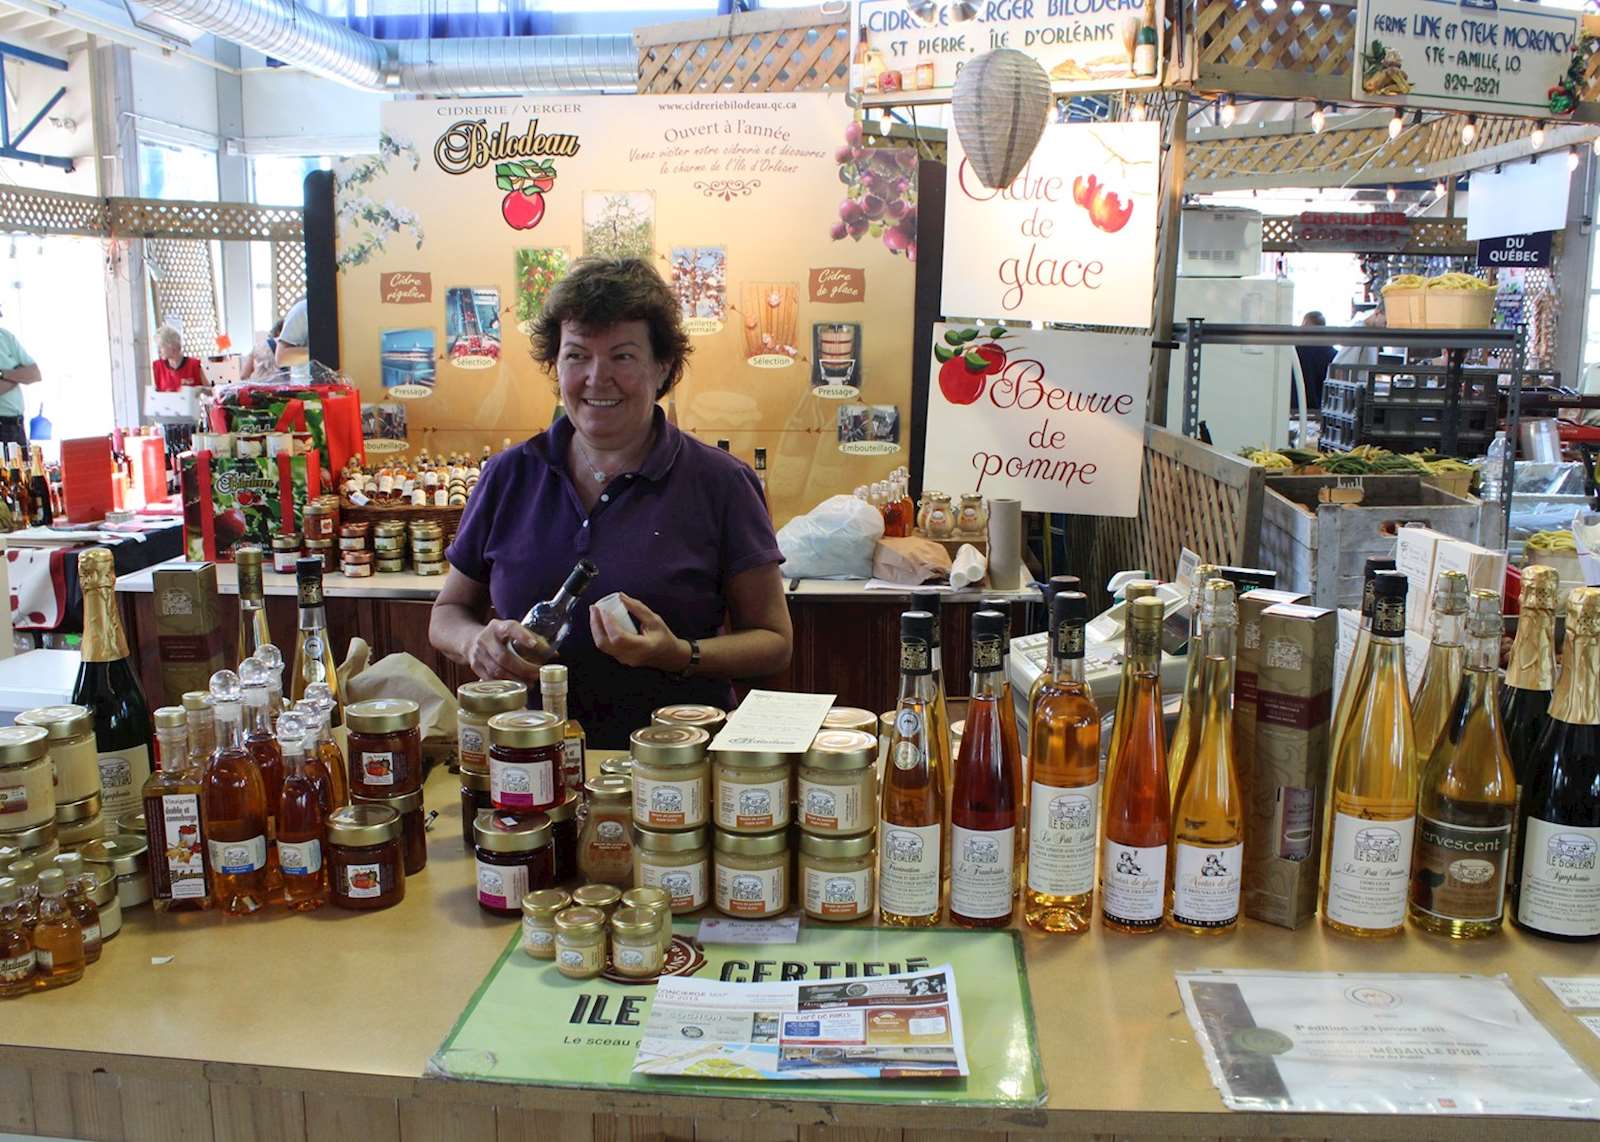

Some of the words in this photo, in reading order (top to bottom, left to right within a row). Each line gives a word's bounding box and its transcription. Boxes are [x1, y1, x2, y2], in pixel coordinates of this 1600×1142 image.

[868, 8, 949, 33] CIDRE
[978, 0, 1034, 22] RGER
[890, 42, 908, 56] ST
[1025, 21, 1115, 46] D'ORLÉANS
[1374, 14, 1407, 34] FERME
[1413, 14, 1441, 40] LINE
[1461, 21, 1498, 46] STEVE
[1504, 27, 1573, 54] MORENCY
[1444, 73, 1500, 95] 829-2521
[658, 101, 797, 111] www.cidreriebilodeau.qc.ca
[664, 122, 719, 143] Ouvert
[724, 121, 732, 133] à
[737, 119, 791, 142] l'année
[434, 119, 581, 175] Bilodeau
[659, 146, 690, 158] visiter
[694, 146, 719, 155] notre
[723, 143, 760, 155] cidrerie
[764, 146, 776, 156] et
[673, 162, 706, 174] charme
[710, 160, 721, 172] de
[1021, 207, 1054, 239] de
[1505, 238, 1525, 249] DU
[1489, 247, 1539, 263] QUÉBEC
[390, 273, 422, 288] Cidre
[818, 268, 852, 284] Cidre
[999, 243, 1104, 311] glace
[816, 285, 828, 297] de
[830, 283, 859, 298] glace
[457, 358, 493, 367] Sélection
[753, 356, 790, 366] Sélection
[394, 387, 428, 397] Pressage
[818, 387, 853, 398] Pressage
[989, 358, 1134, 415] Beurre
[1028, 419, 1066, 450] de
[366, 441, 408, 451] bouteillage
[843, 444, 898, 454] Embouteillage
[972, 451, 1098, 493] pomme
[1424, 831, 1501, 852] ervescent
[569, 994, 648, 1026] ILE
[564, 1035, 582, 1045] Le
[587, 1036, 631, 1046] sceau
